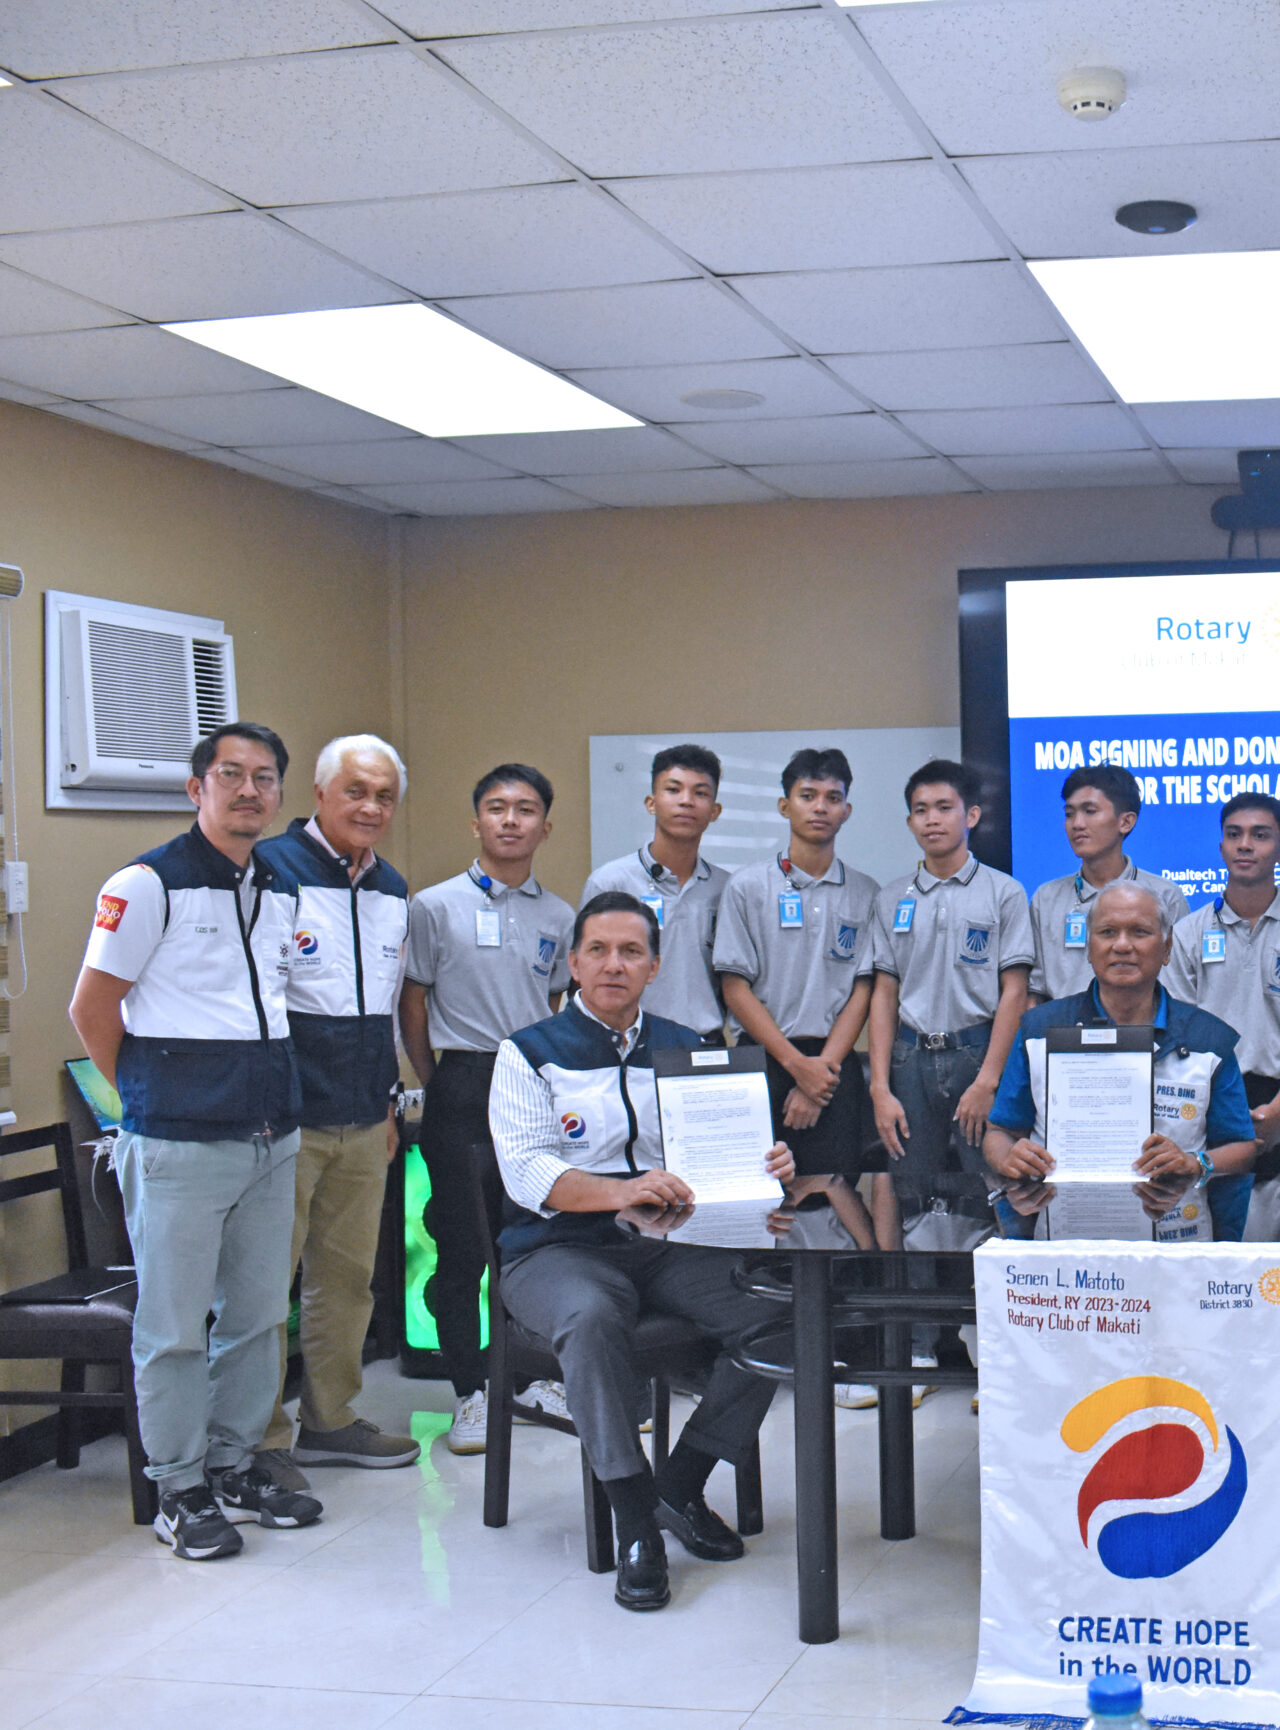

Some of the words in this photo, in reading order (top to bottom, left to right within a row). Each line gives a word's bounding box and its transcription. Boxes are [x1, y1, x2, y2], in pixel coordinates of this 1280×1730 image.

[1156, 616, 1252, 645] Rotary
[1034, 740, 1085, 770] MOA
[1088, 738, 1178, 768] SIGNING
[1182, 737, 1229, 767] AND
[1162, 775, 1203, 804] THE
[1161, 868, 1217, 881] Dualtech
[1156, 1085, 1176, 1097] PRES.
[1177, 1087, 1196, 1099] BING
[1006, 1264, 1049, 1287] Senen
[1056, 1267, 1070, 1288] L.
[1075, 1269, 1125, 1291] Matoto
[1207, 1280, 1253, 1298] Rotary
[1006, 1288, 1062, 1310] President,
[1064, 1295, 1081, 1310] RY
[1084, 1296, 1152, 1313] 2023-2024
[1200, 1299, 1230, 1310] District
[1007, 1308, 1044, 1333] Rotary
[1048, 1312, 1074, 1332] Club
[1077, 1314, 1092, 1332] of
[1096, 1315, 1141, 1335] Makati
[1058, 1616, 1163, 1645] CREATE
[1174, 1619, 1250, 1647] HOPE
[1059, 1651, 1083, 1677] in
[1091, 1654, 1138, 1677] the
[1147, 1655, 1251, 1686] WORLD
